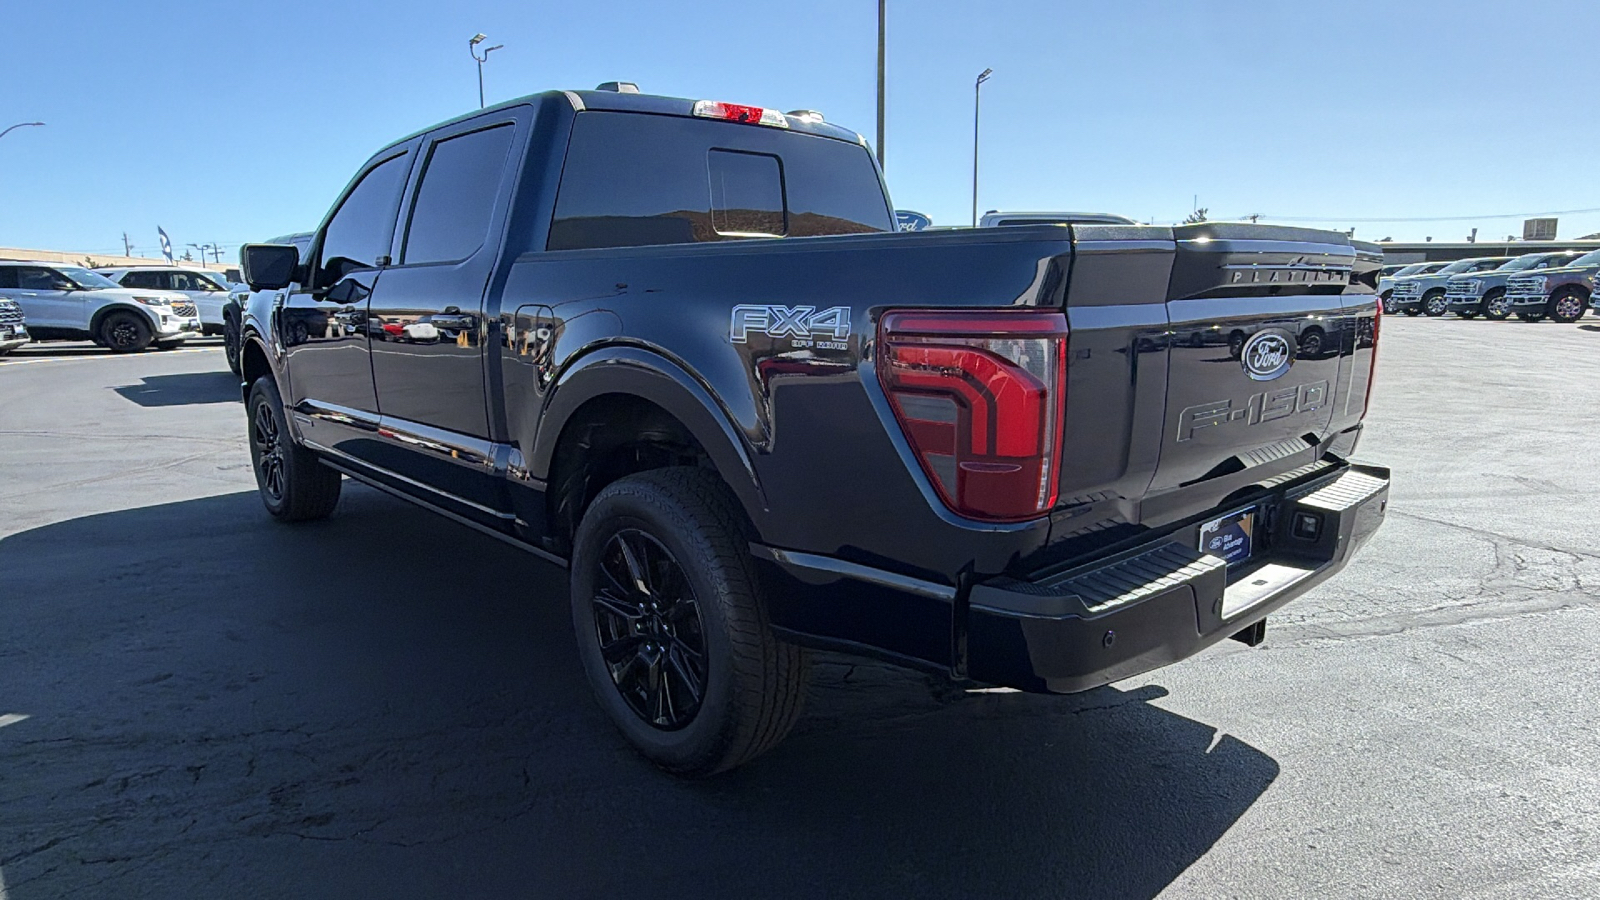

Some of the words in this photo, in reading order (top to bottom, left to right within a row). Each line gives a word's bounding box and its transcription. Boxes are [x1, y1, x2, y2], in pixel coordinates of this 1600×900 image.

[897, 216, 918, 231] rd
[730, 304, 851, 343] FX4
[1254, 341, 1283, 368] Ford
[1177, 380, 1329, 442] F-150
